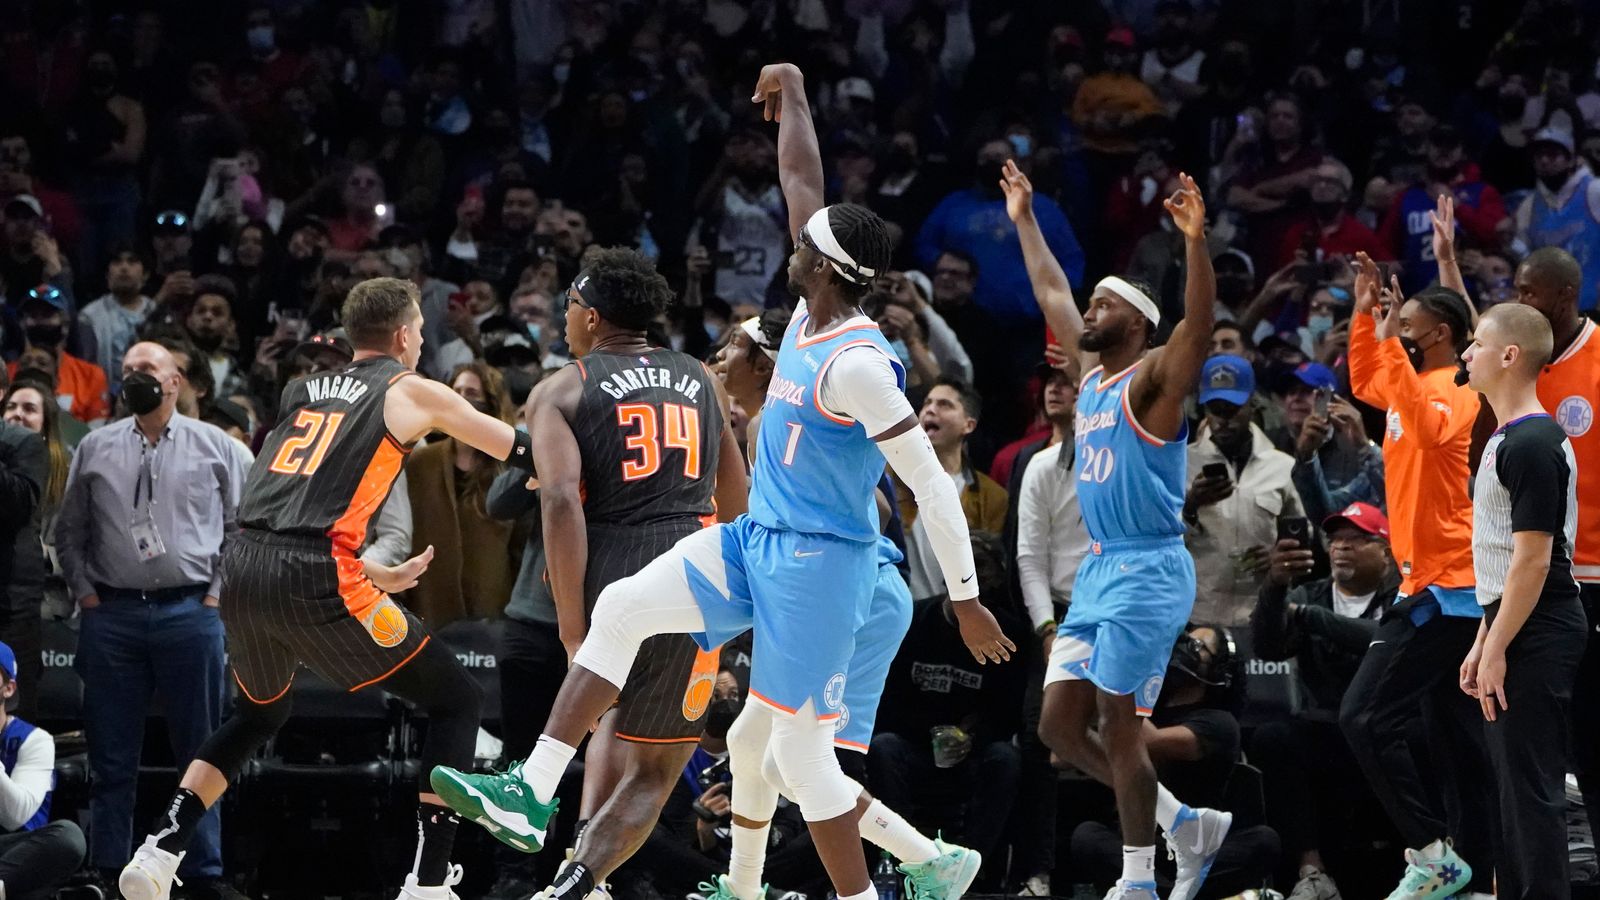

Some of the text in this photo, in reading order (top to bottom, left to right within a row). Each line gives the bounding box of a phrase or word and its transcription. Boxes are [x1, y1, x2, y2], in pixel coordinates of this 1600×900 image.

[600, 367, 701, 404] CARTER JR.
[269, 409, 346, 476] 21
[615, 402, 700, 482] 34
[783, 421, 803, 468] 1
[1080, 445, 1114, 483] 20
[455, 650, 497, 668] pira
[735, 651, 751, 667] A
